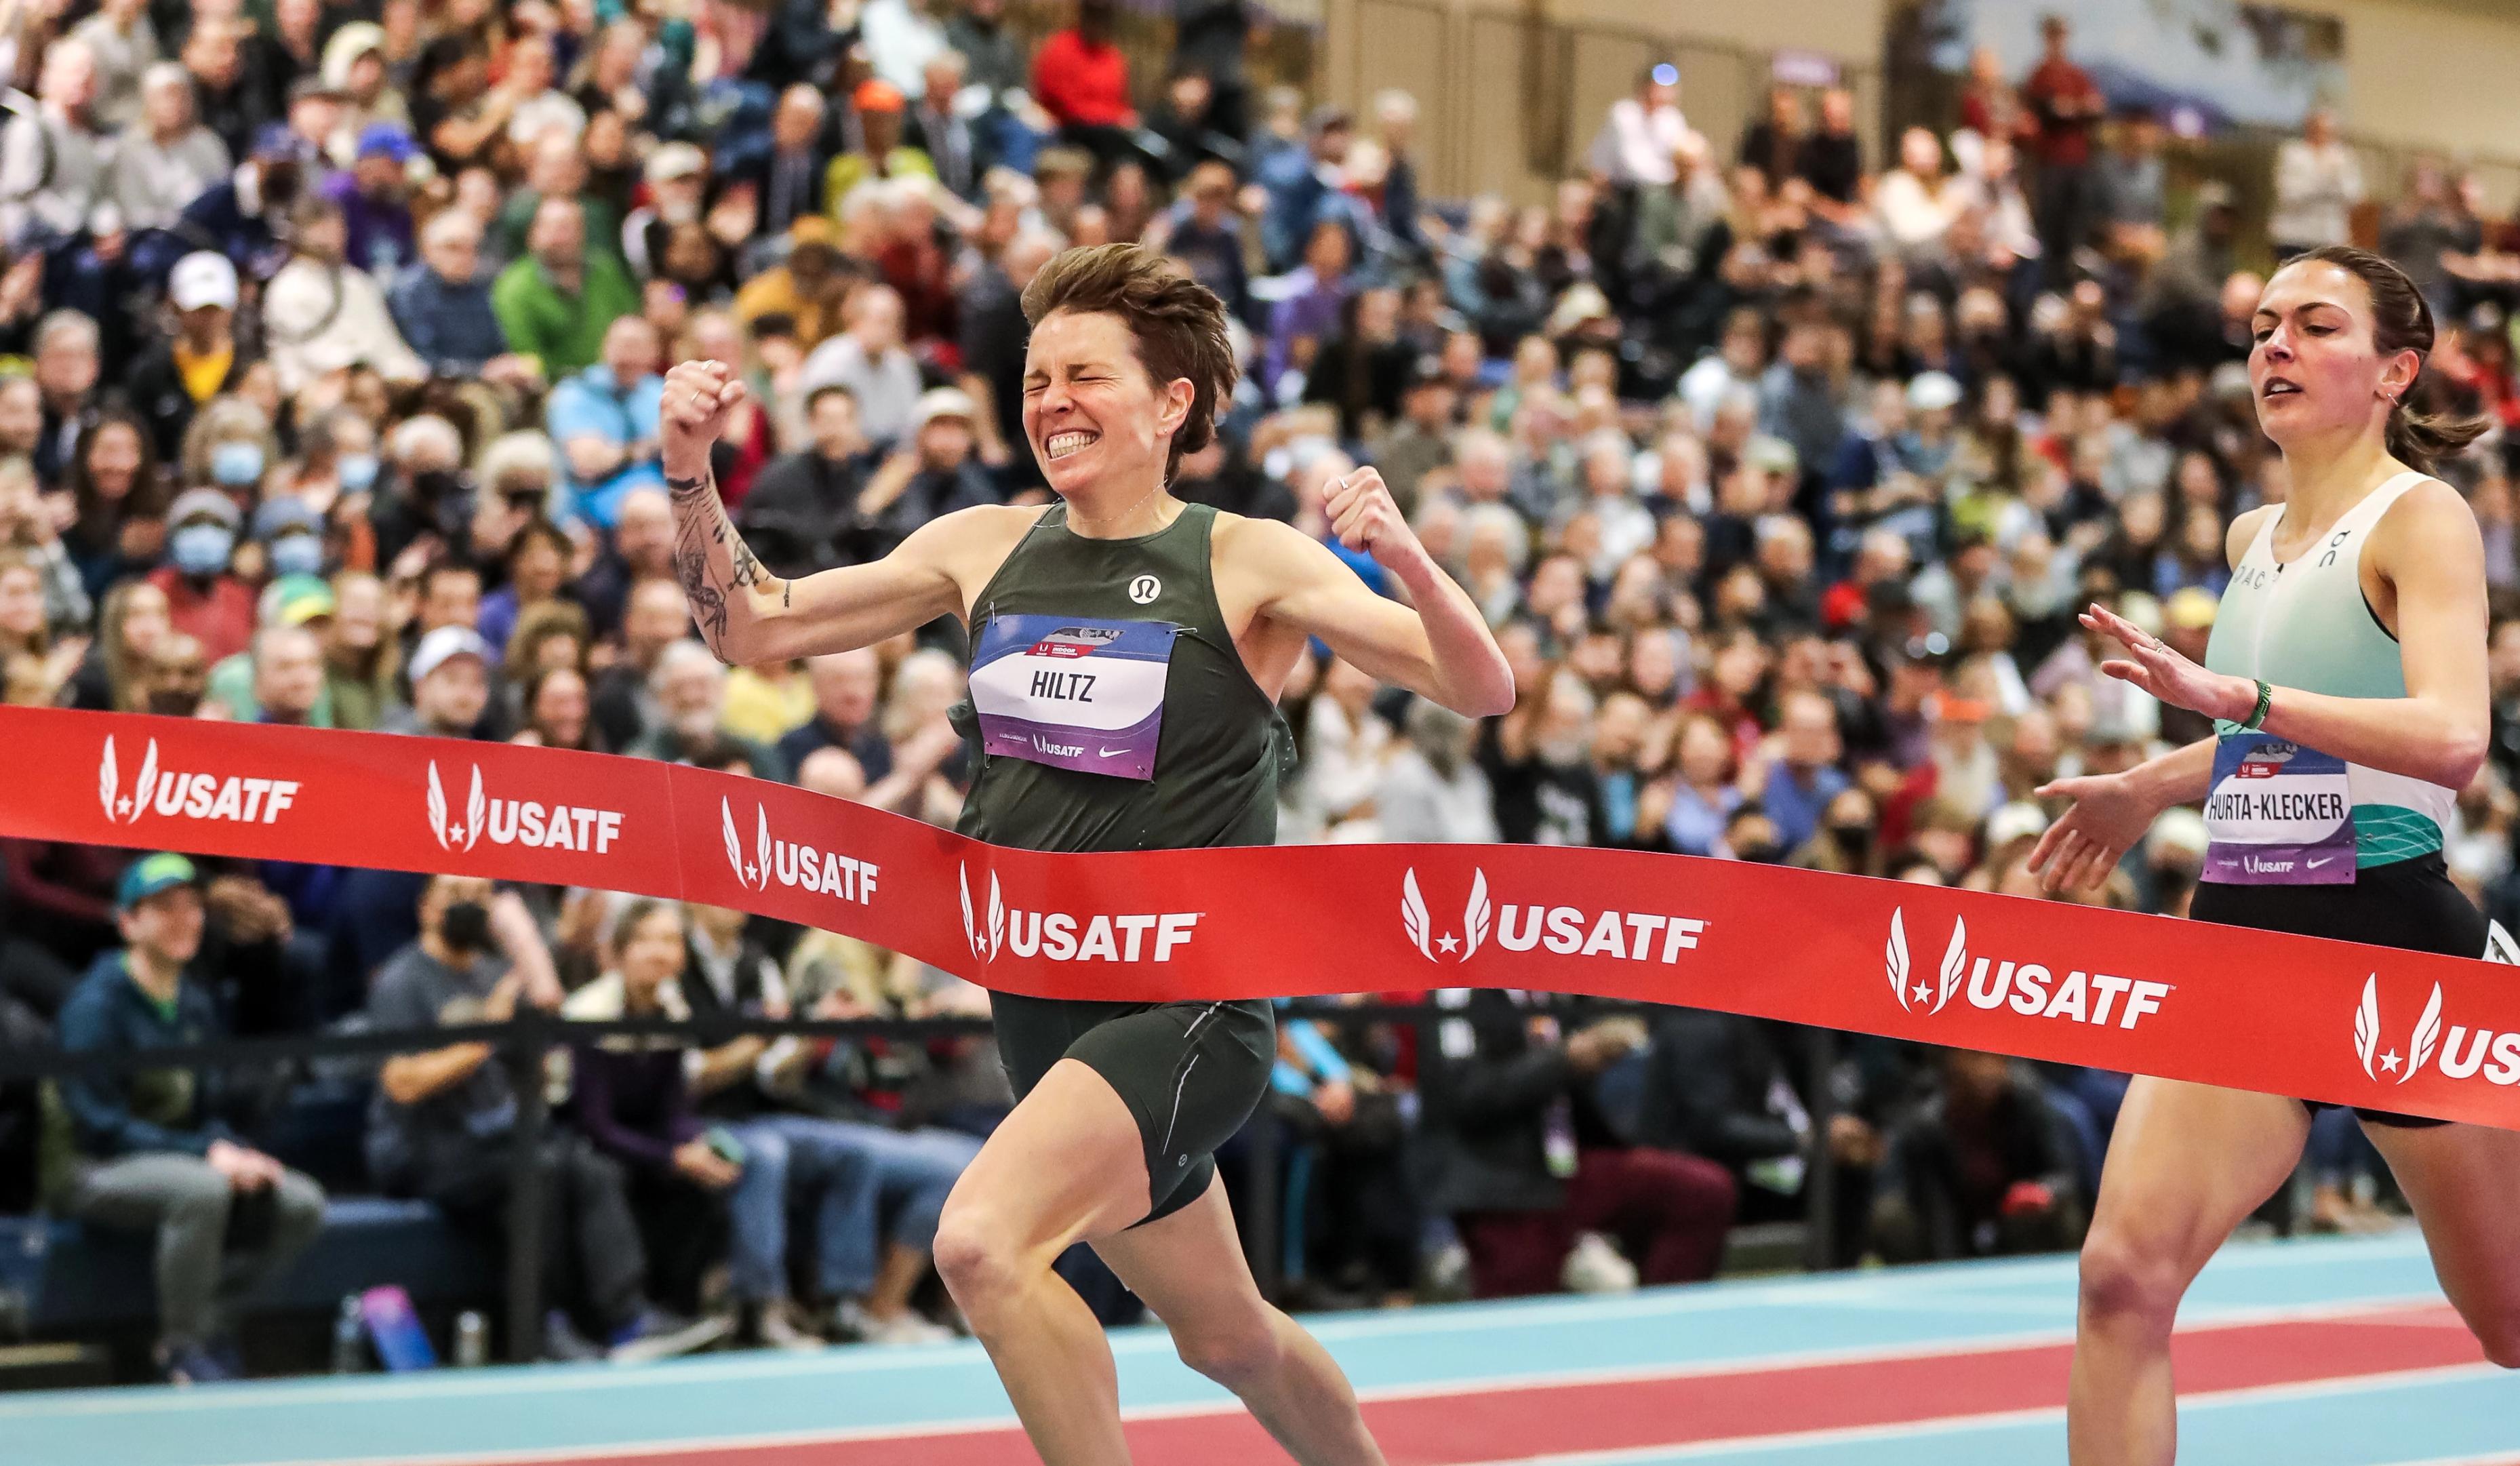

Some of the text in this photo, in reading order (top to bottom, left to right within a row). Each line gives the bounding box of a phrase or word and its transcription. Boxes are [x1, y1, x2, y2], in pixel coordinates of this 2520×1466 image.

[1030, 670, 1096, 702] HILTZ
[1047, 743, 1084, 757] USATF
[155, 771, 300, 825] USATF
[2208, 793, 2344, 820] HURTA-KLECKER
[488, 798, 622, 854] USATF
[775, 839, 878, 906] USATF
[2260, 861, 2294, 873] USATF
[1009, 909, 1198, 963] USATF
[1496, 904, 1705, 964] USATF
[1967, 956, 2170, 1031] USATF
[2439, 1025, 2520, 1086] US
